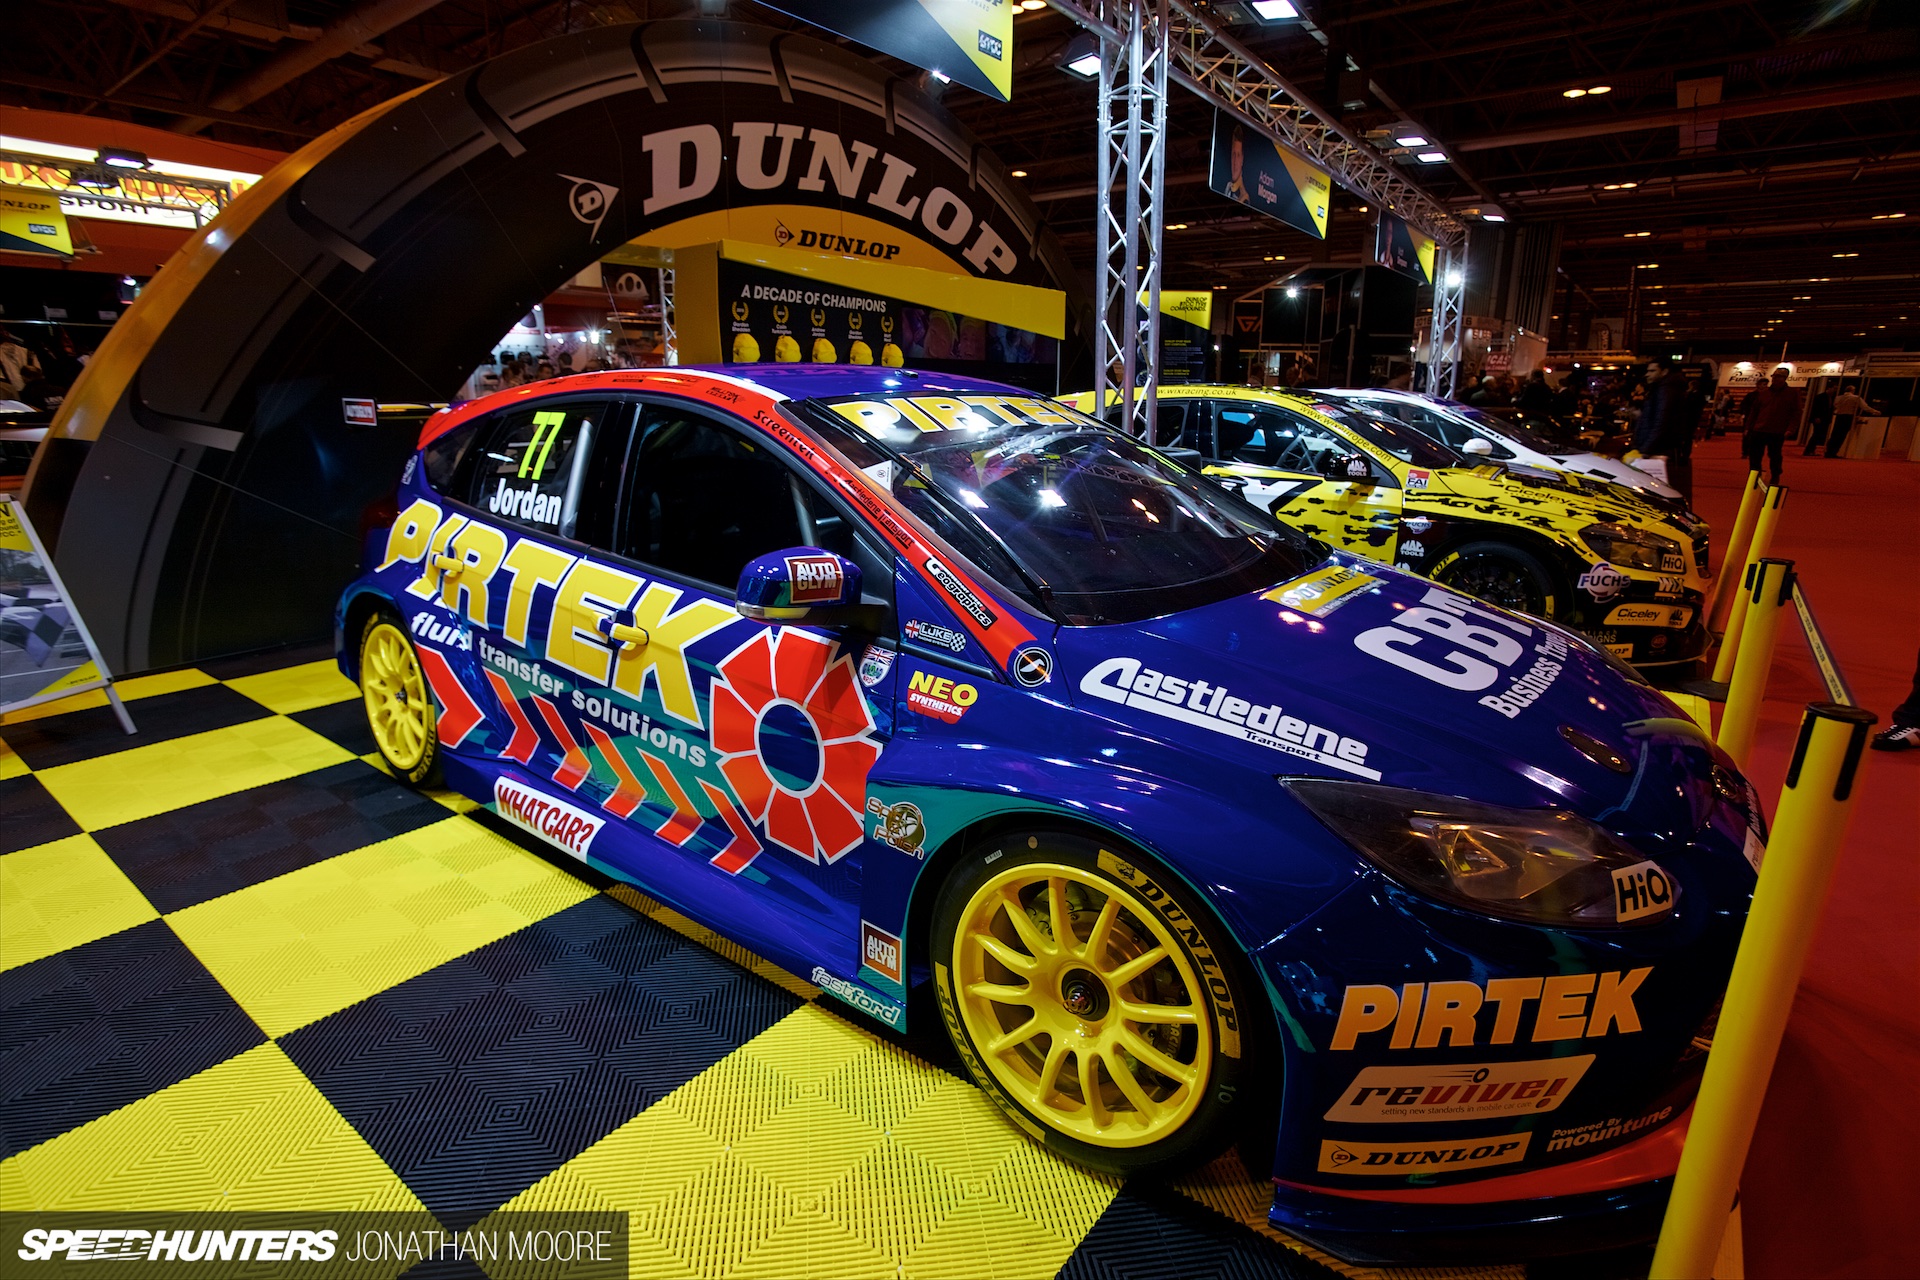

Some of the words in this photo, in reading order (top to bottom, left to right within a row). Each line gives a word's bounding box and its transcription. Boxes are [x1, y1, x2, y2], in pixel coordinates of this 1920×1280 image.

[0, 199, 50, 211] NLOP
[59, 194, 150, 214] SPORT
[642, 121, 1017, 277] DUNLOP
[797, 229, 900, 260] DUNLOP
[741, 284, 750, 299] A
[754, 285, 802, 304] DECADE
[804, 291, 820, 306] OF
[822, 293, 886, 313] CHAMPIONS
[828, 395, 1107, 440] PIRTEK
[518, 411, 566, 480] 77
[489, 478, 563, 525] Jordan
[1504, 484, 1569, 505] Ciceley
[797, 562, 836, 579] AUTO
[1662, 556, 1683, 569] HiQ
[797, 575, 836, 591] GLYM
[926, 558, 992, 626] Geographics
[1580, 575, 1631, 588] FUCHS
[1657, 577, 1685, 593] WIX
[374, 498, 742, 730] PIRTEK
[1617, 608, 1660, 622] Ciceley
[921, 625, 951, 641] LUKE
[411, 611, 472, 651] fluid
[479, 637, 564, 697] transfer
[572, 688, 707, 768] solutions
[908, 670, 978, 707] NEO
[1478, 656, 1562, 719] Business
[1242, 729, 1322, 761] Transport
[875, 827, 924, 859] Polish
[1617, 867, 1670, 913] HiQ
[867, 933, 897, 958] AUTO
[867, 946, 897, 971] GLYM
[1135, 878, 1238, 1034] DUNLOP
[812, 966, 901, 1025] fastford
[1329, 965, 1655, 1051] PIRTEK
[1350, 1068, 1568, 1109] revive!
[1381, 1106, 1407, 1116] setting
[1410, 1107, 1425, 1115] new
[1428, 1105, 1465, 1114] standards
[1467, 1104, 1474, 1112] in
[1477, 1103, 1502, 1112] mobile
[1504, 1102, 1515, 1110] car
[1517, 1101, 1532, 1109] care
[1546, 1106, 1673, 1152] mountune
[1552, 1120, 1604, 1138] Powered
[1606, 1118, 1622, 1127] By
[1361, 1141, 1520, 1165] DUNLOP
